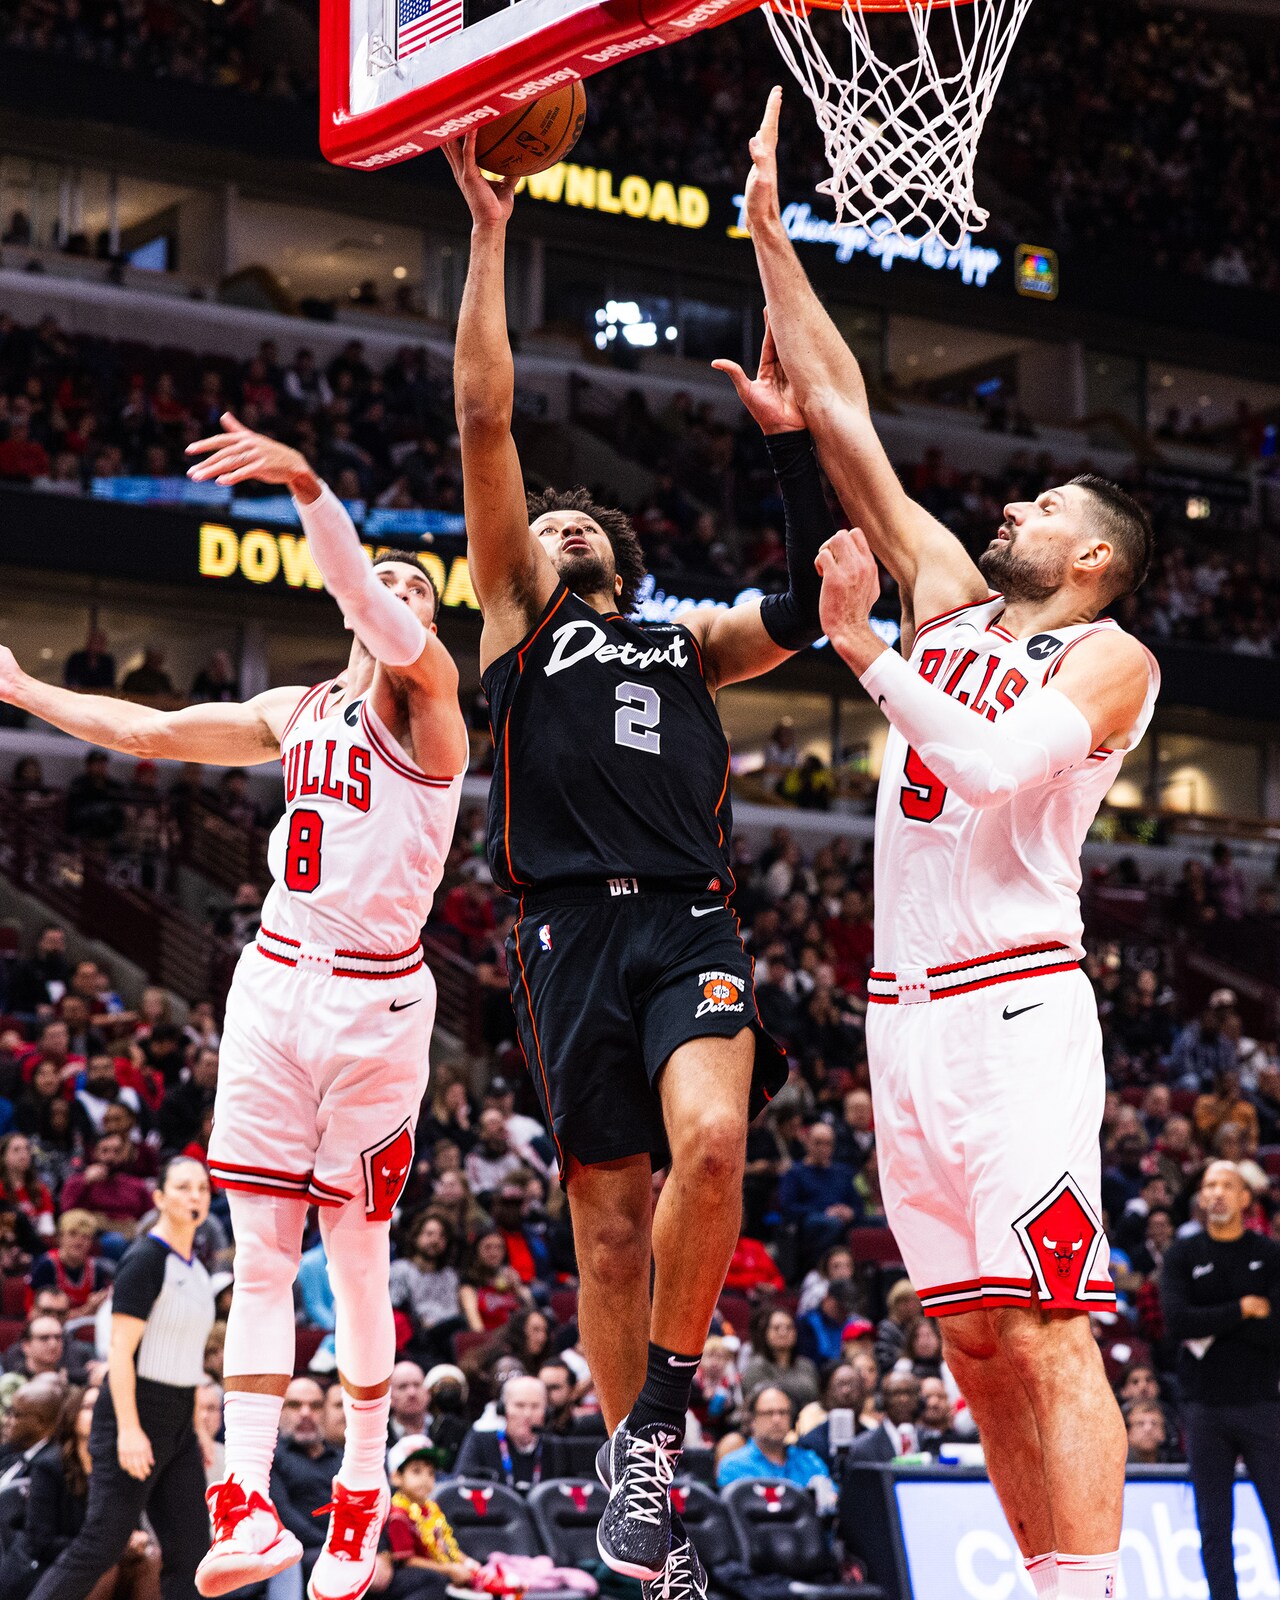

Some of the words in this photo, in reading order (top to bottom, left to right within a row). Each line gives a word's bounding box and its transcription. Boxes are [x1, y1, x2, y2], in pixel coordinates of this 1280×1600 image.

[668, 0, 732, 28] betw
[582, 33, 665, 63] betway
[500, 66, 581, 100] betway
[423, 104, 500, 138] betway
[349, 141, 424, 168] betway
[480, 161, 710, 230] WNLOAD
[198, 521, 482, 610] DOWOA
[917, 647, 1029, 723] BLLS
[615, 680, 661, 754] 2
[281, 739, 372, 814] ULLS
[284, 808, 324, 894] 8
[698, 971, 745, 993] PISTONS
[694, 997, 745, 1019] Detroit
